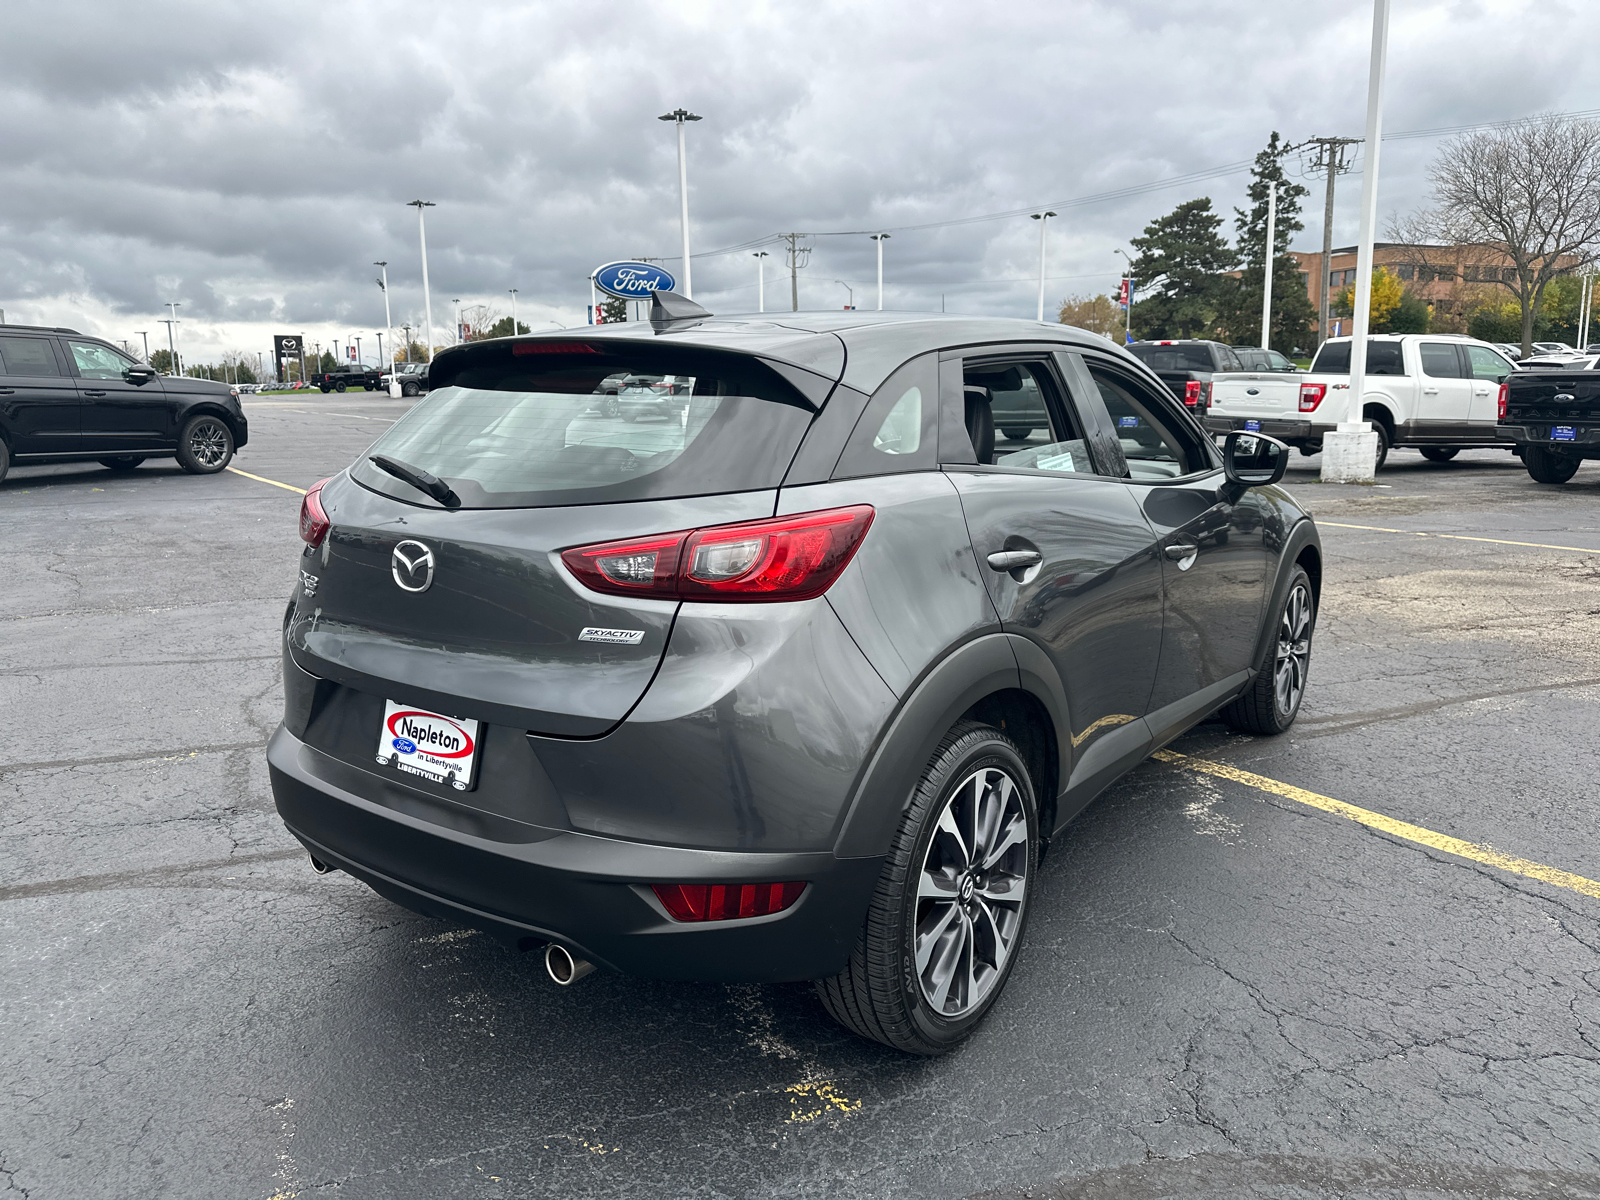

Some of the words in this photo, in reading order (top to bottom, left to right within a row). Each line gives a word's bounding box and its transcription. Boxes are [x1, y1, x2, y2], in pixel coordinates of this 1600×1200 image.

[613, 268, 660, 291] Ford
[586, 629, 637, 637] SKYACTIV
[401, 717, 460, 751] Napleton
[396, 740, 413, 753] Ford
[397, 762, 444, 783] LIBERTYVILLE
[417, 752, 424, 761] in
[425, 754, 463, 773] Libertyville
